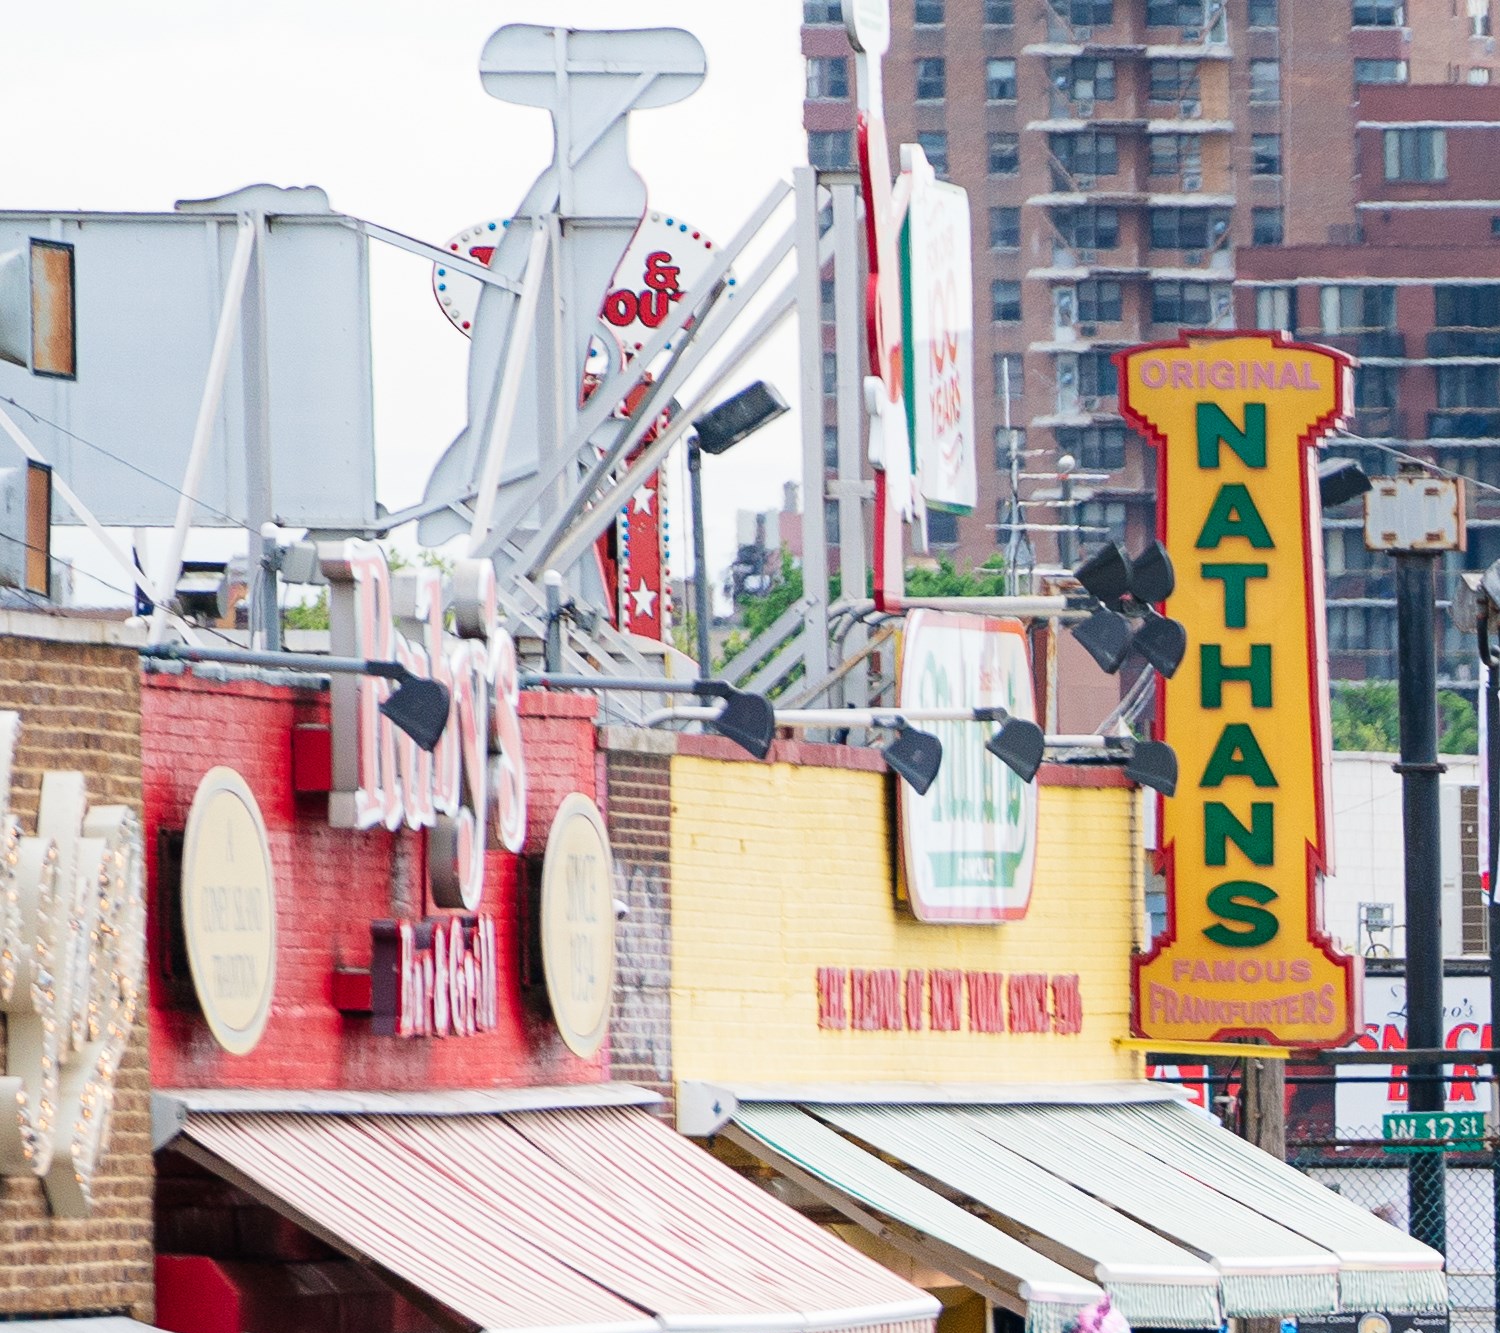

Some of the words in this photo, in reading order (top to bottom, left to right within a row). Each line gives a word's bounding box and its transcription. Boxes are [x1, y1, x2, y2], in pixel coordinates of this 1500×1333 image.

[1140, 358, 1321, 390] ORIGINAL
[1195, 402, 1280, 948] NATHANS
[1172, 958, 1313, 984] FAMOUS
[928, 969, 962, 1031] NEW
[966, 971, 1004, 1032] YORK
[1150, 980, 1336, 1025] FRANKFURTERS
[1388, 1118, 1416, 1139] W
[1425, 1117, 1455, 1147] 12
[1460, 1116, 1477, 1135] St
